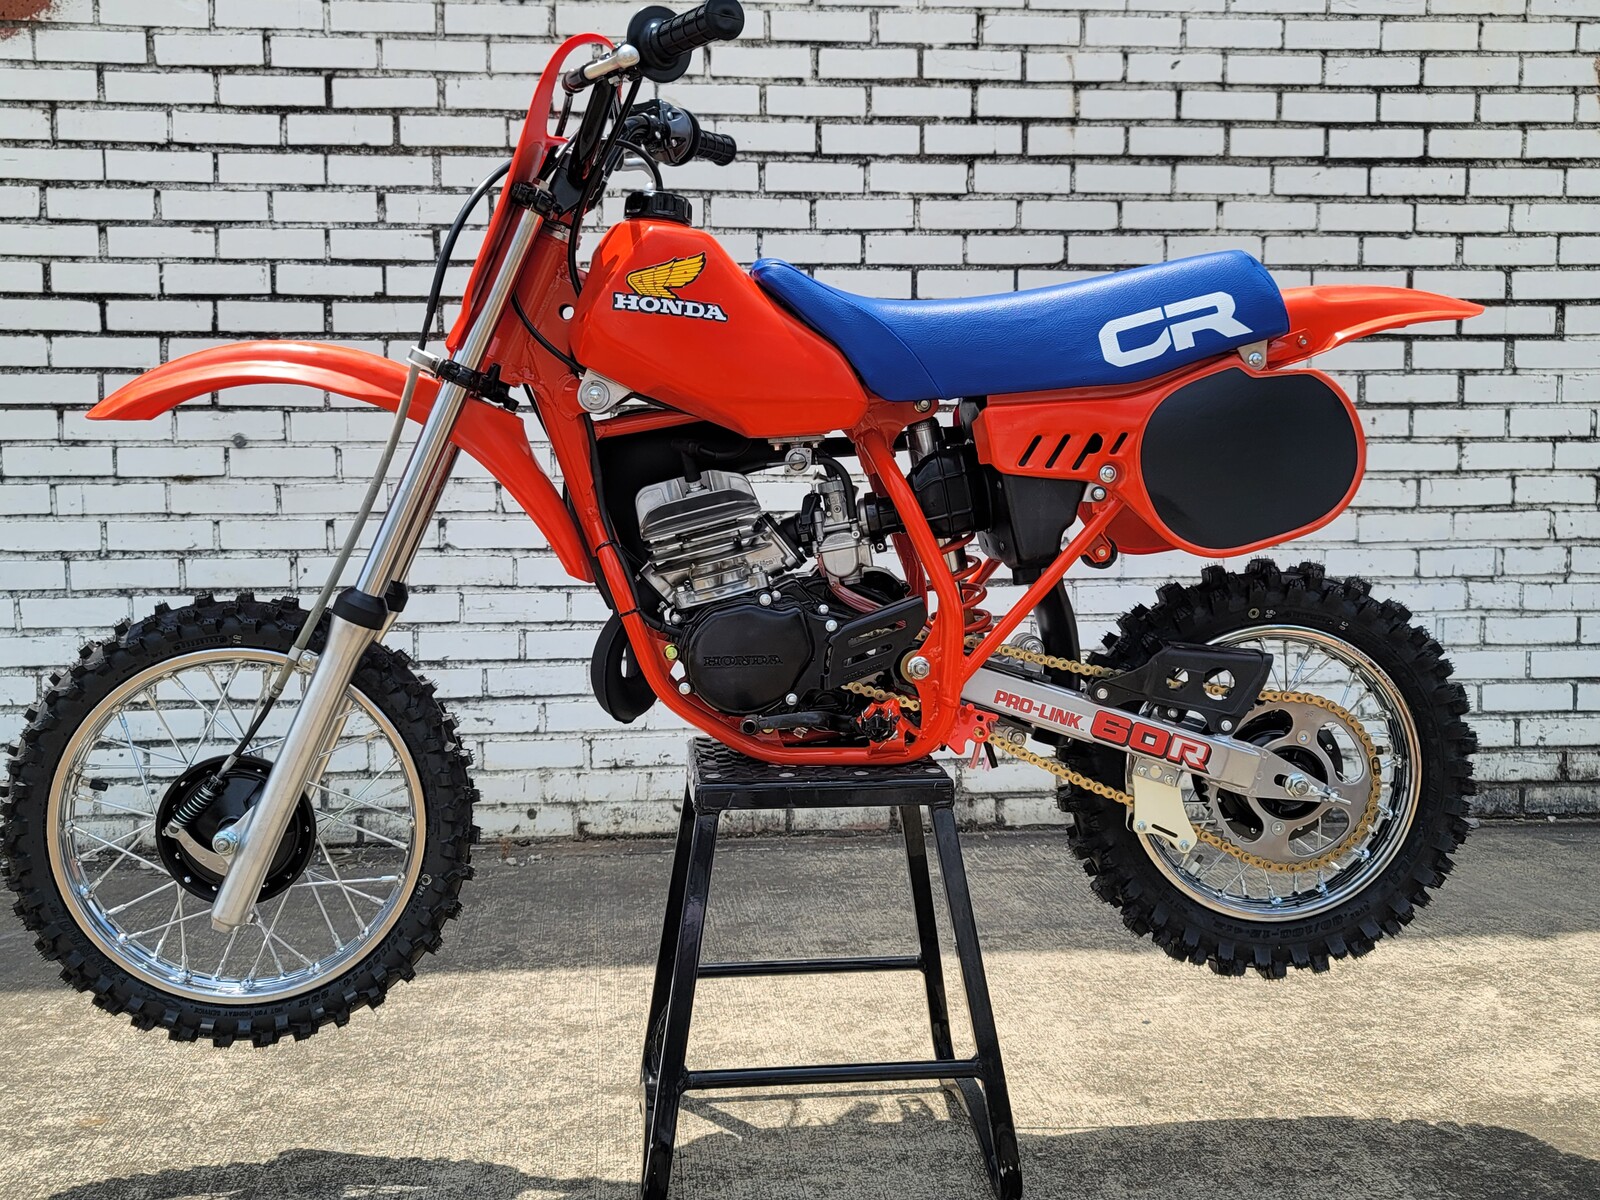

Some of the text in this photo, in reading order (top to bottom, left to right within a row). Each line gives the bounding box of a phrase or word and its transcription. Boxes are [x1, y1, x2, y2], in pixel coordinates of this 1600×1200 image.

[614, 293, 727, 321] HONDA
[1099, 291, 1253, 367] CR
[703, 654, 784, 668] HONDA
[994, 690, 1213, 774] PRO-LINK 60R
